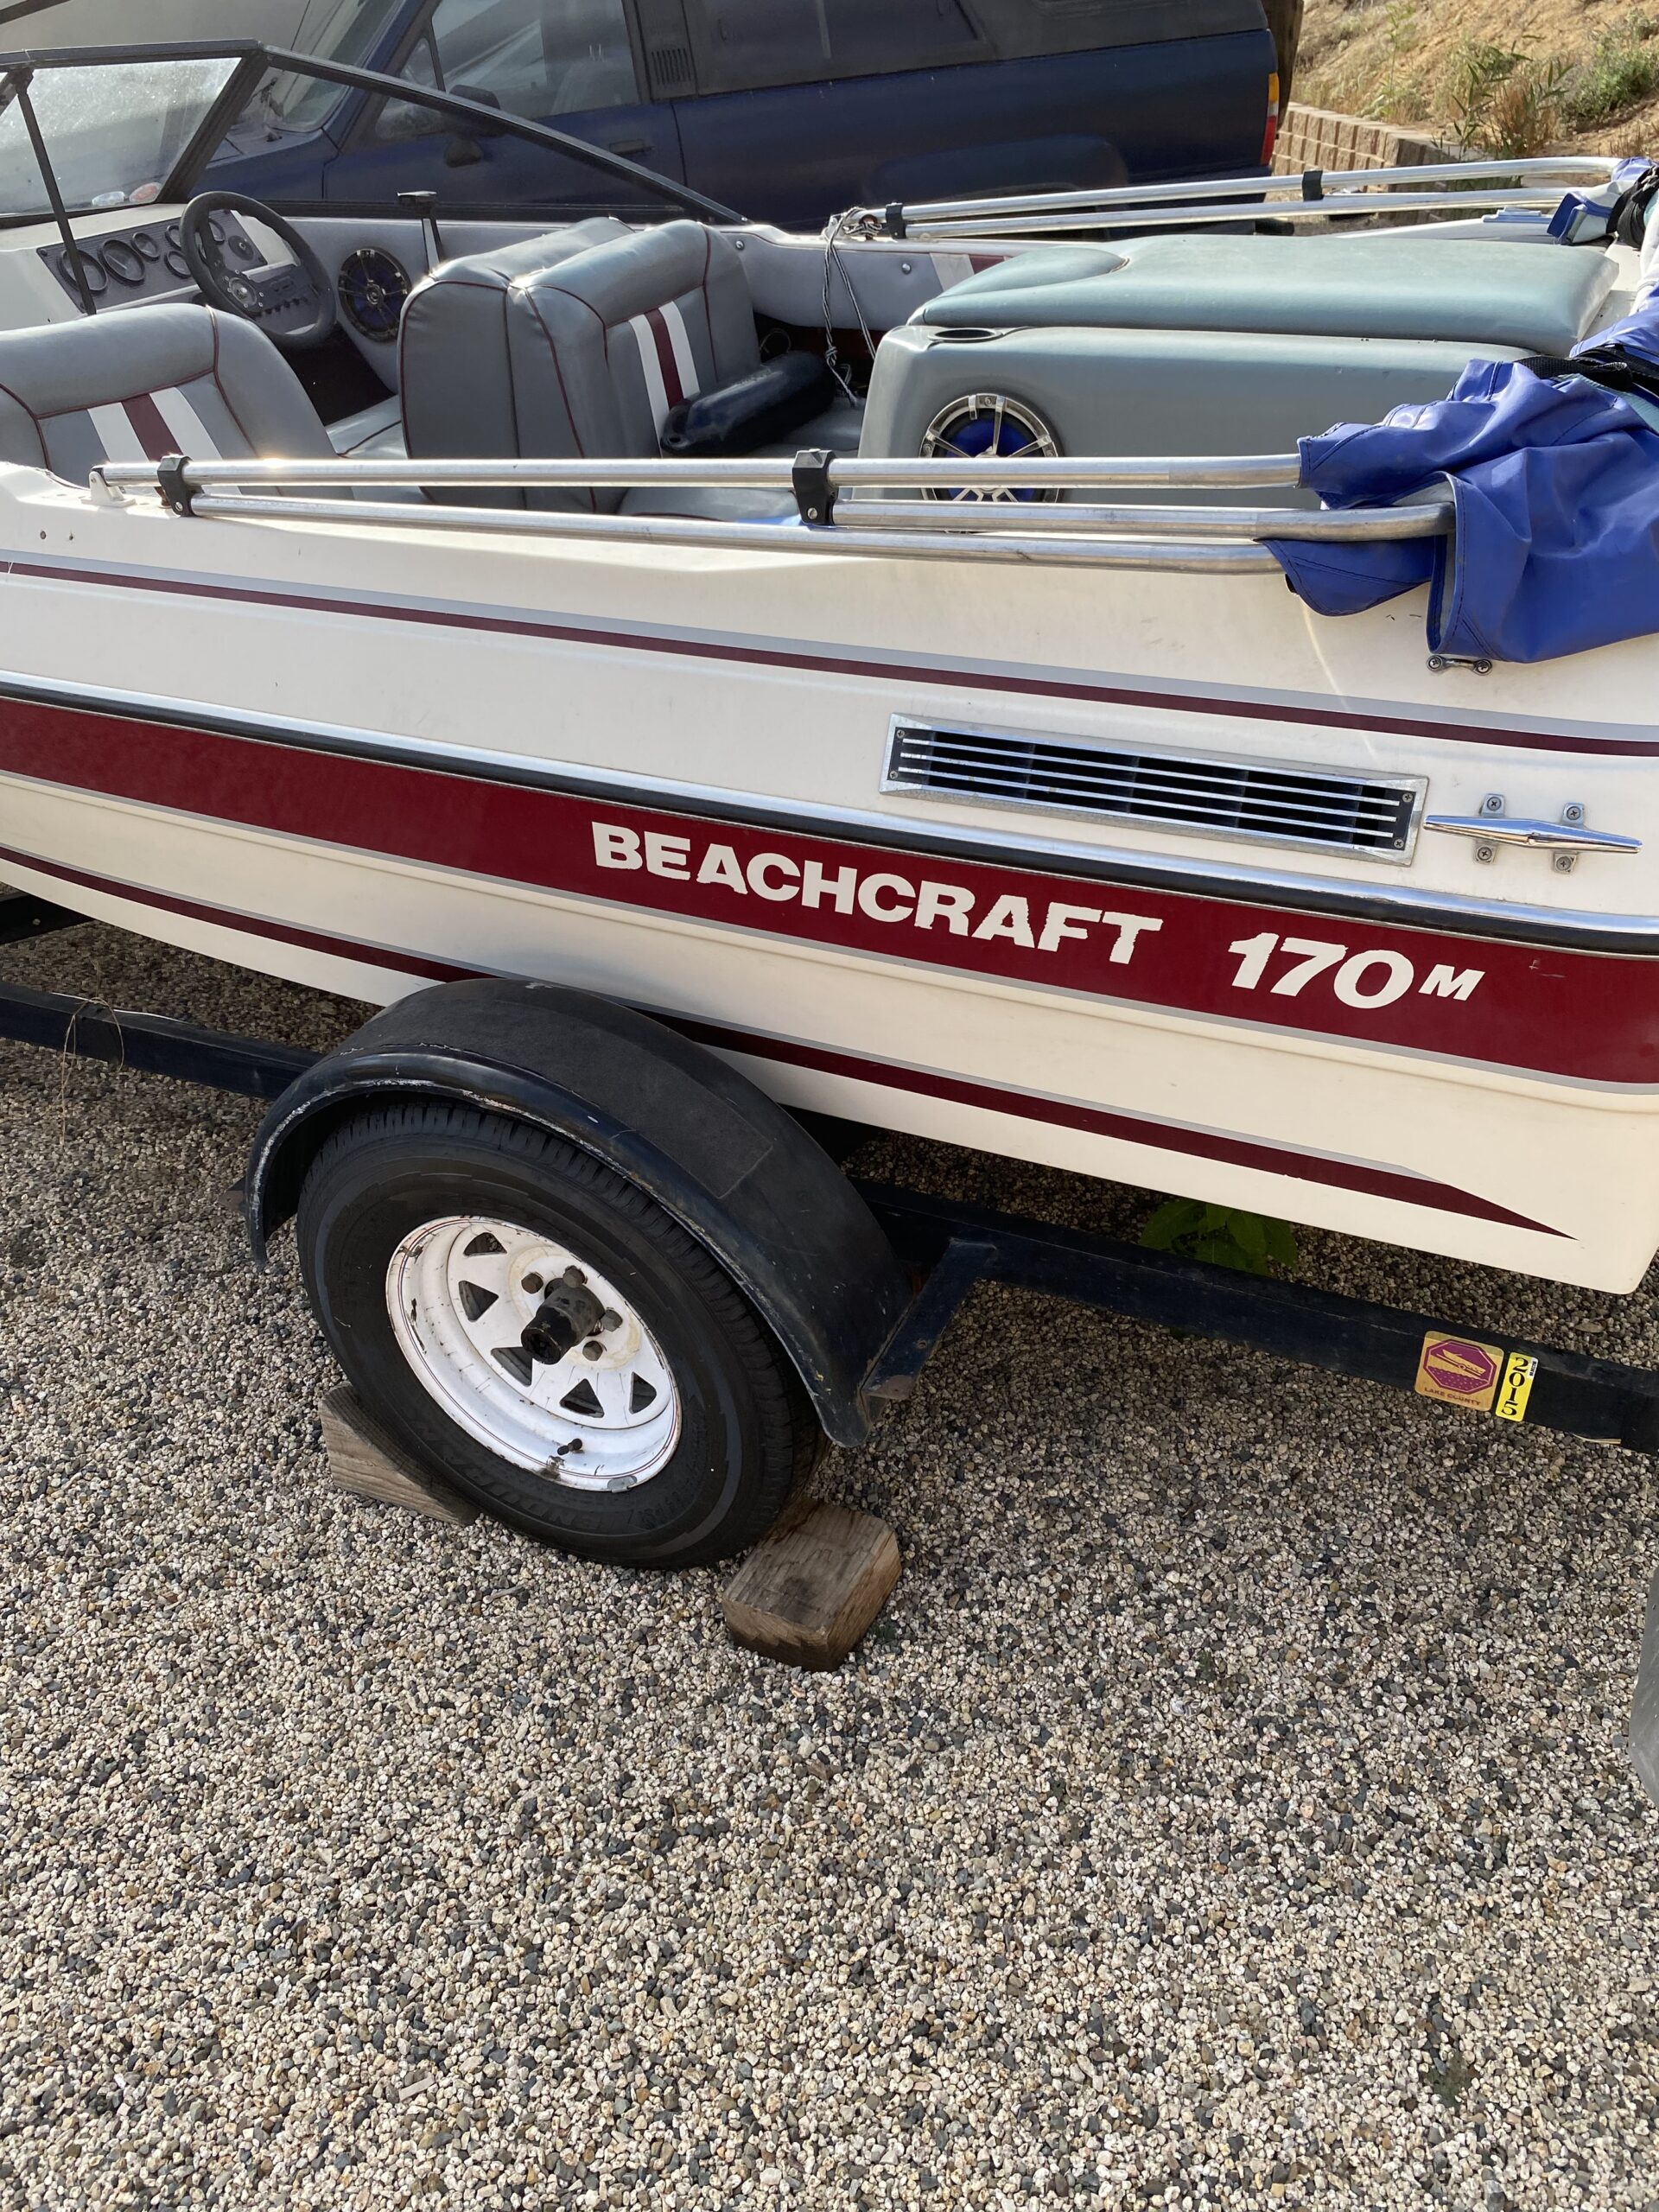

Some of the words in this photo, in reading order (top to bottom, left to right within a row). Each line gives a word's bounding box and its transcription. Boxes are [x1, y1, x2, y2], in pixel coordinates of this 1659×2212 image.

[591, 821, 1164, 965] BEACHCRAFT
[1228, 931, 1415, 1009] 170
[1418, 963, 1486, 1001] M
[1424, 1387, 1446, 1396] LAKE
[1446, 1393, 1482, 1406] COUNTY
[1501, 1357, 1529, 1416] 2015
